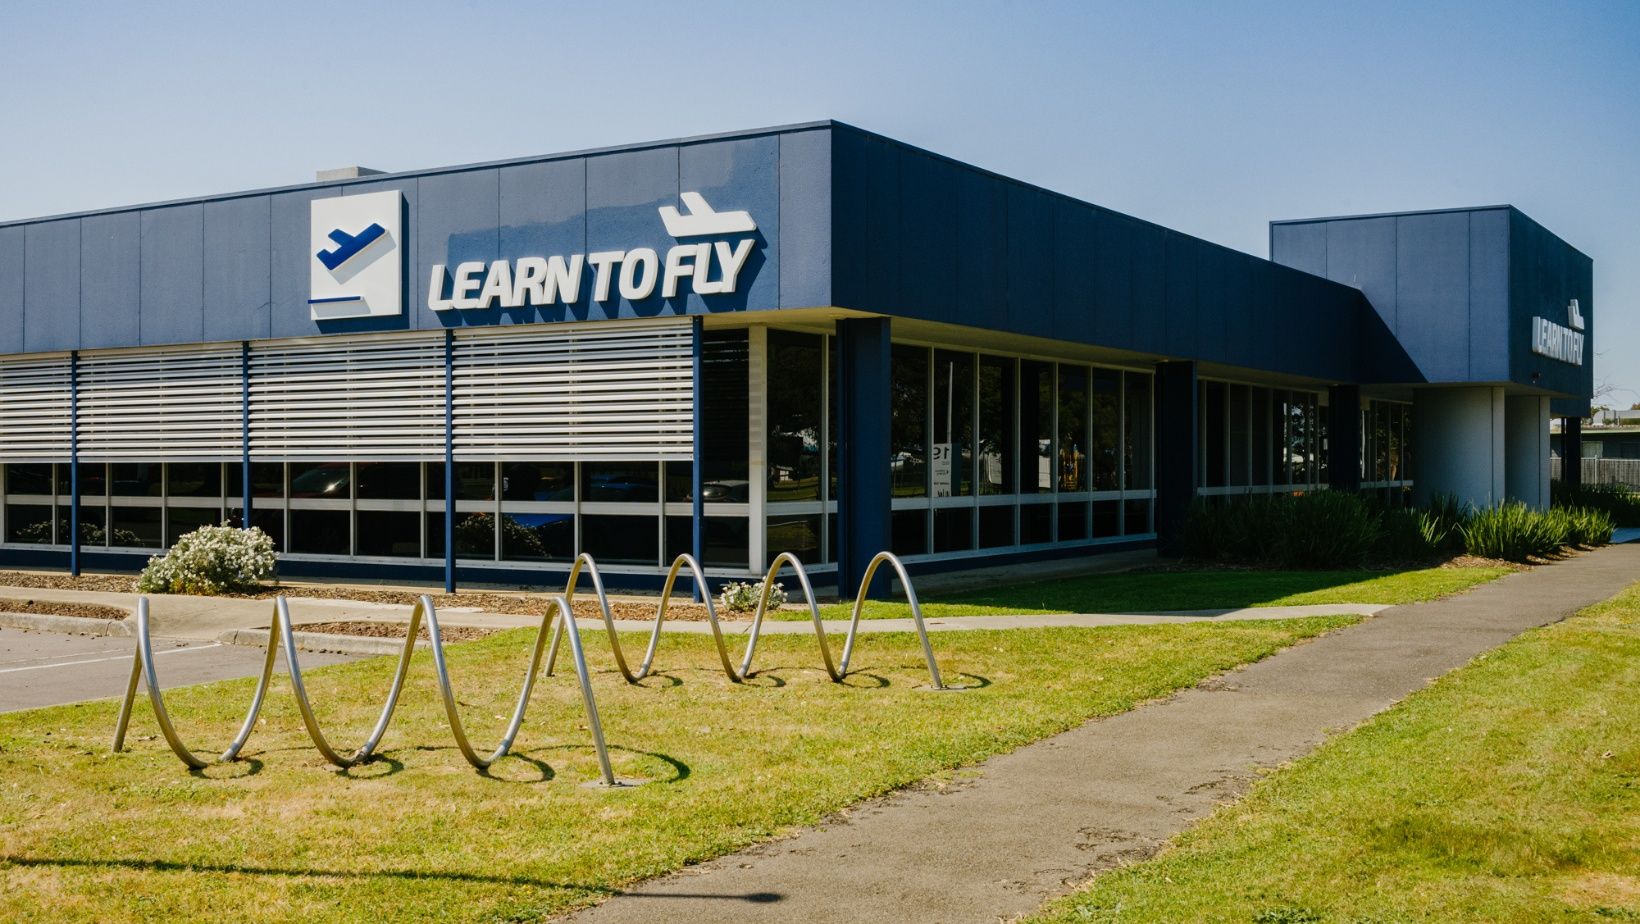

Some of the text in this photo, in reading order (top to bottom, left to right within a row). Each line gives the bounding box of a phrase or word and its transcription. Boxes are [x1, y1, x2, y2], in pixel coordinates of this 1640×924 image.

[428, 238, 757, 311] LEARN TO FLY
[1532, 316, 1563, 360] LEARN
[1562, 327, 1574, 364] TO
